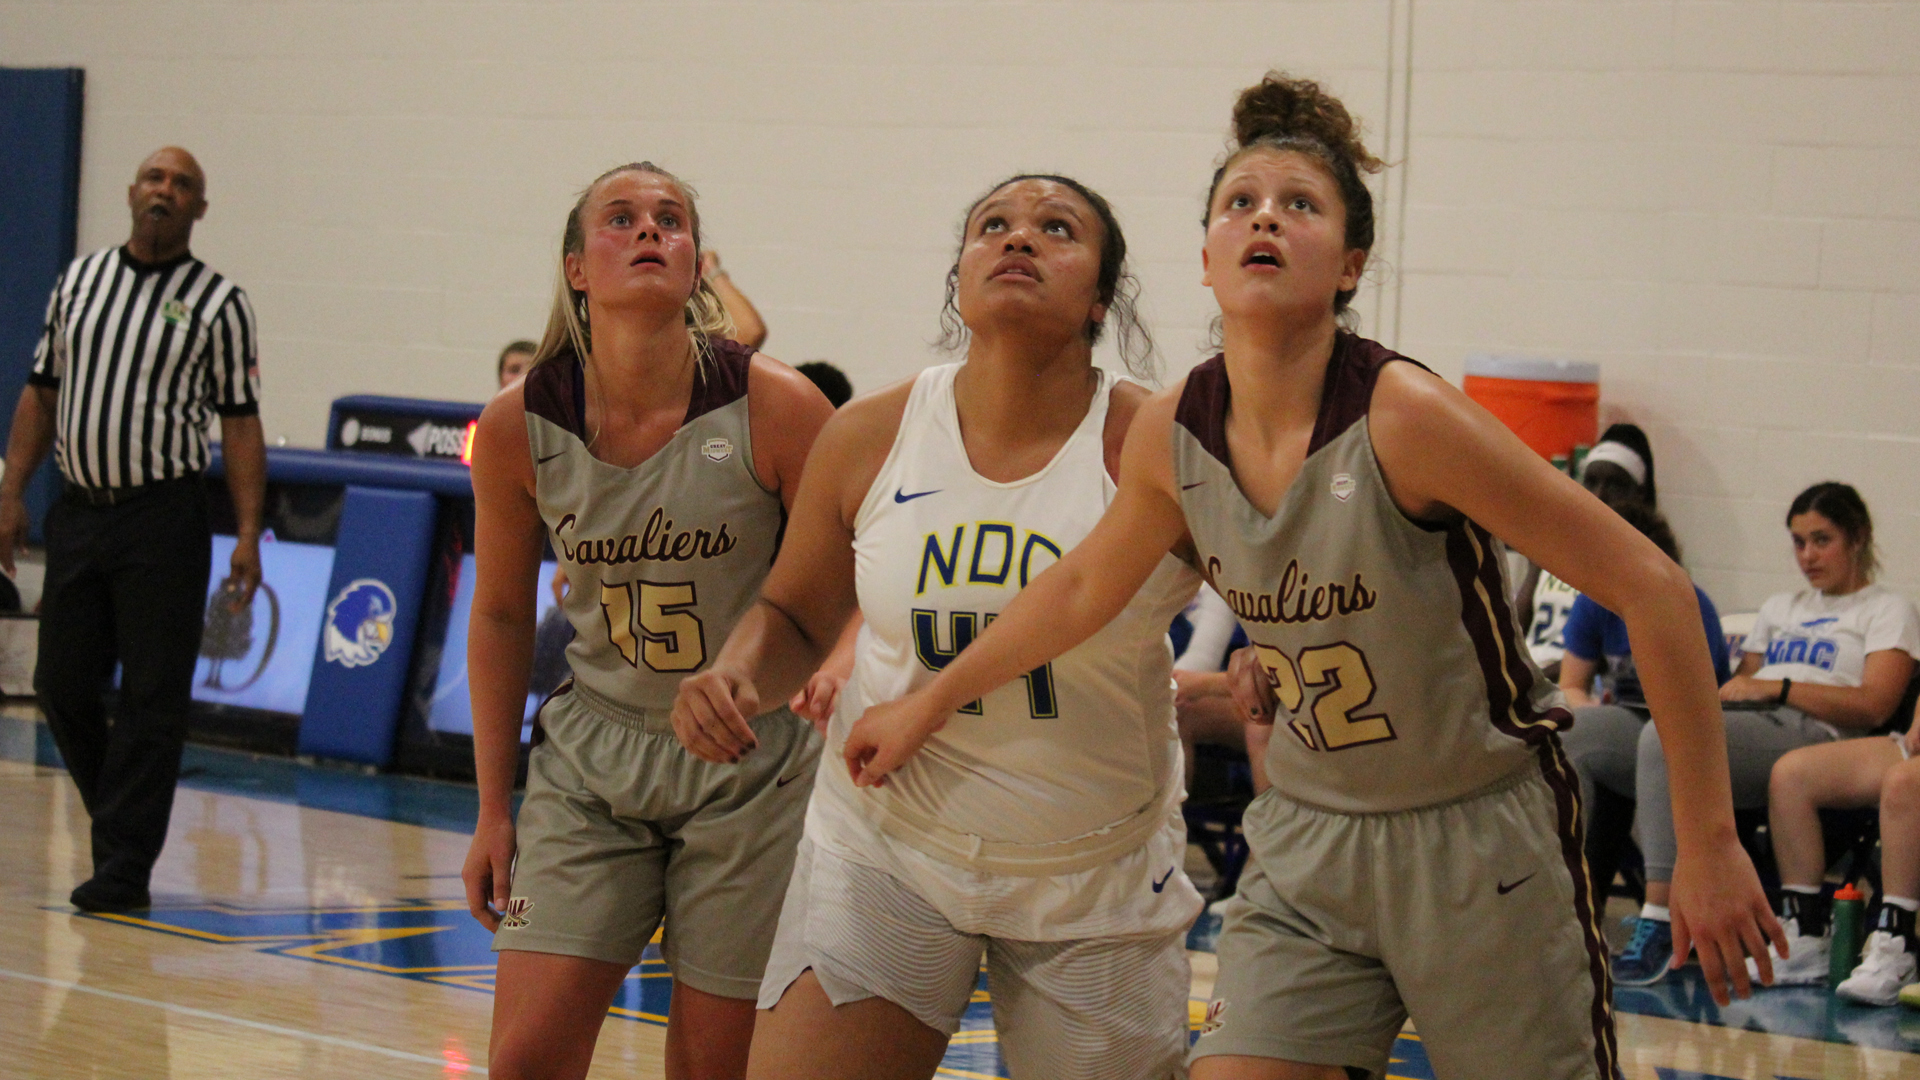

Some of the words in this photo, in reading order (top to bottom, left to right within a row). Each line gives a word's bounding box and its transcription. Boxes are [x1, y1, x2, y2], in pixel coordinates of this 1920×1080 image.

[555, 507, 738, 566] Cavaliers
[1208, 555, 1377, 624] Cavaliers
[600, 579, 707, 673] 15
[1765, 638, 1837, 670] NDC
[1252, 640, 1397, 751] 22
